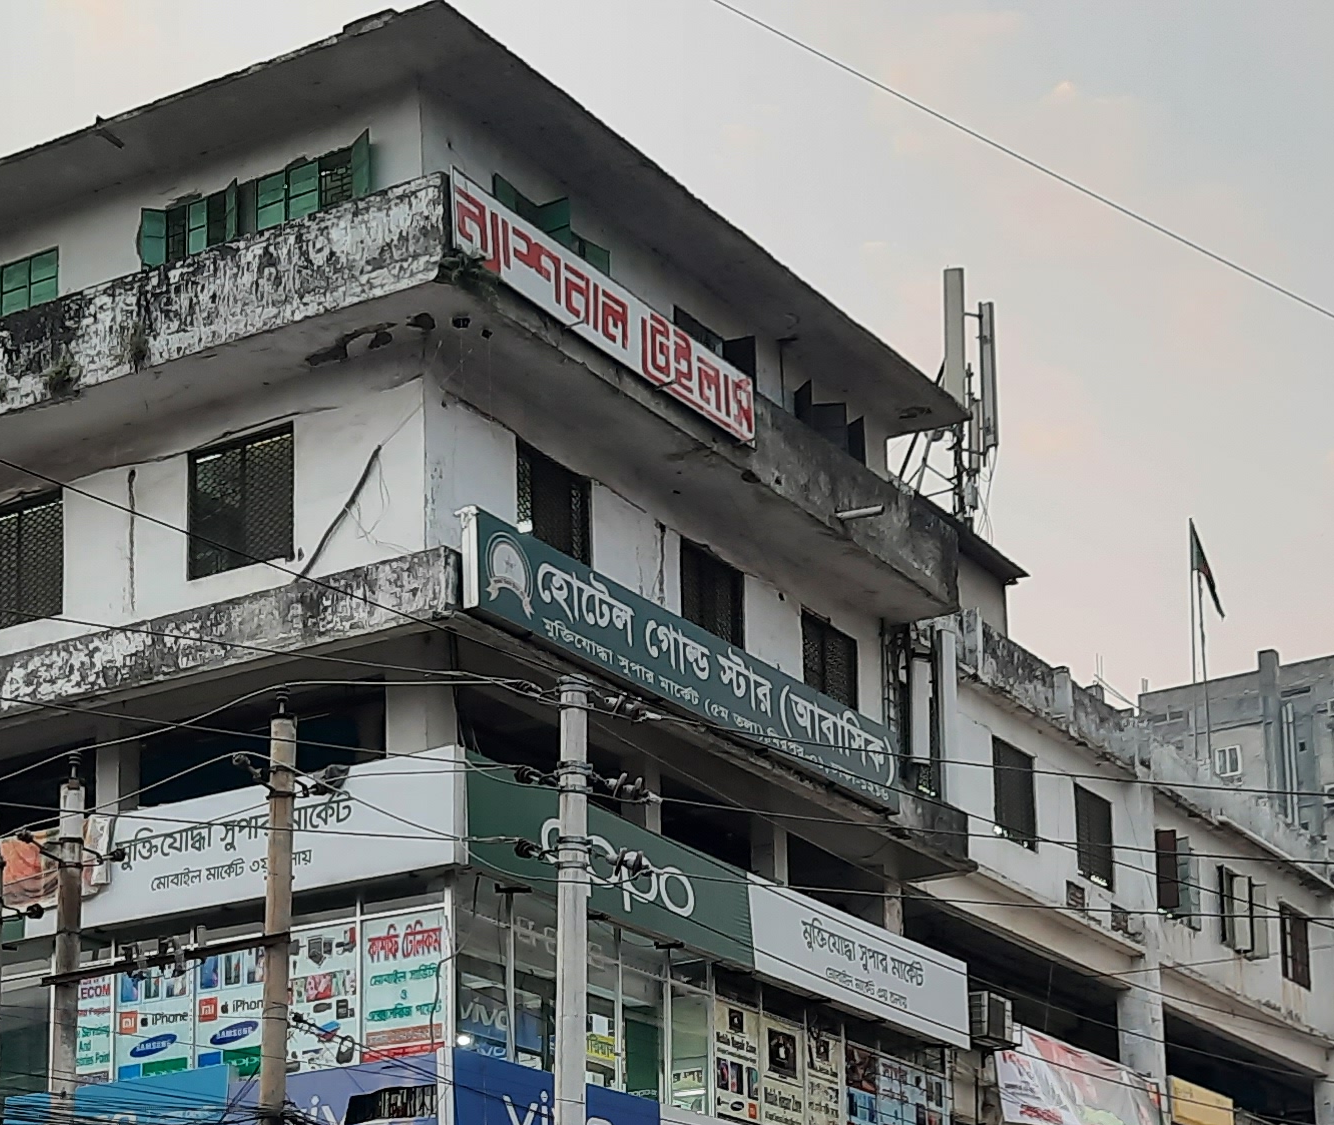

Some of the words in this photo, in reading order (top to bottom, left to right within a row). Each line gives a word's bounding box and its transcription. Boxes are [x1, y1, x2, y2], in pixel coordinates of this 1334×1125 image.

[455, 185, 629, 350] ন্যাশনাল
[641, 310, 754, 442] টেইলার্স
[537, 562, 635, 648] হোটেল
[646, 618, 712, 681] গোল্ড
[717, 646, 772, 718] স্টার
[780, 684, 896, 786] (আবাসিক)
[542, 617, 614, 665] মুক্তিযোদ্ধা
[617, 654, 655, 684] সুপার
[658, 674, 700, 706] মার্কেট
[116, 822, 214, 871] মুক্তিযোদ্ধা
[151, 865, 201, 892] মোবাইল
[206, 857, 244, 881] মার্কেট
[801, 917, 856, 961] মুক্তিযোদ্ধা
[859, 943, 888, 975] সুপার
[890, 956, 924, 987] মার্কেট
[232, 999, 264, 1012] iPhon
